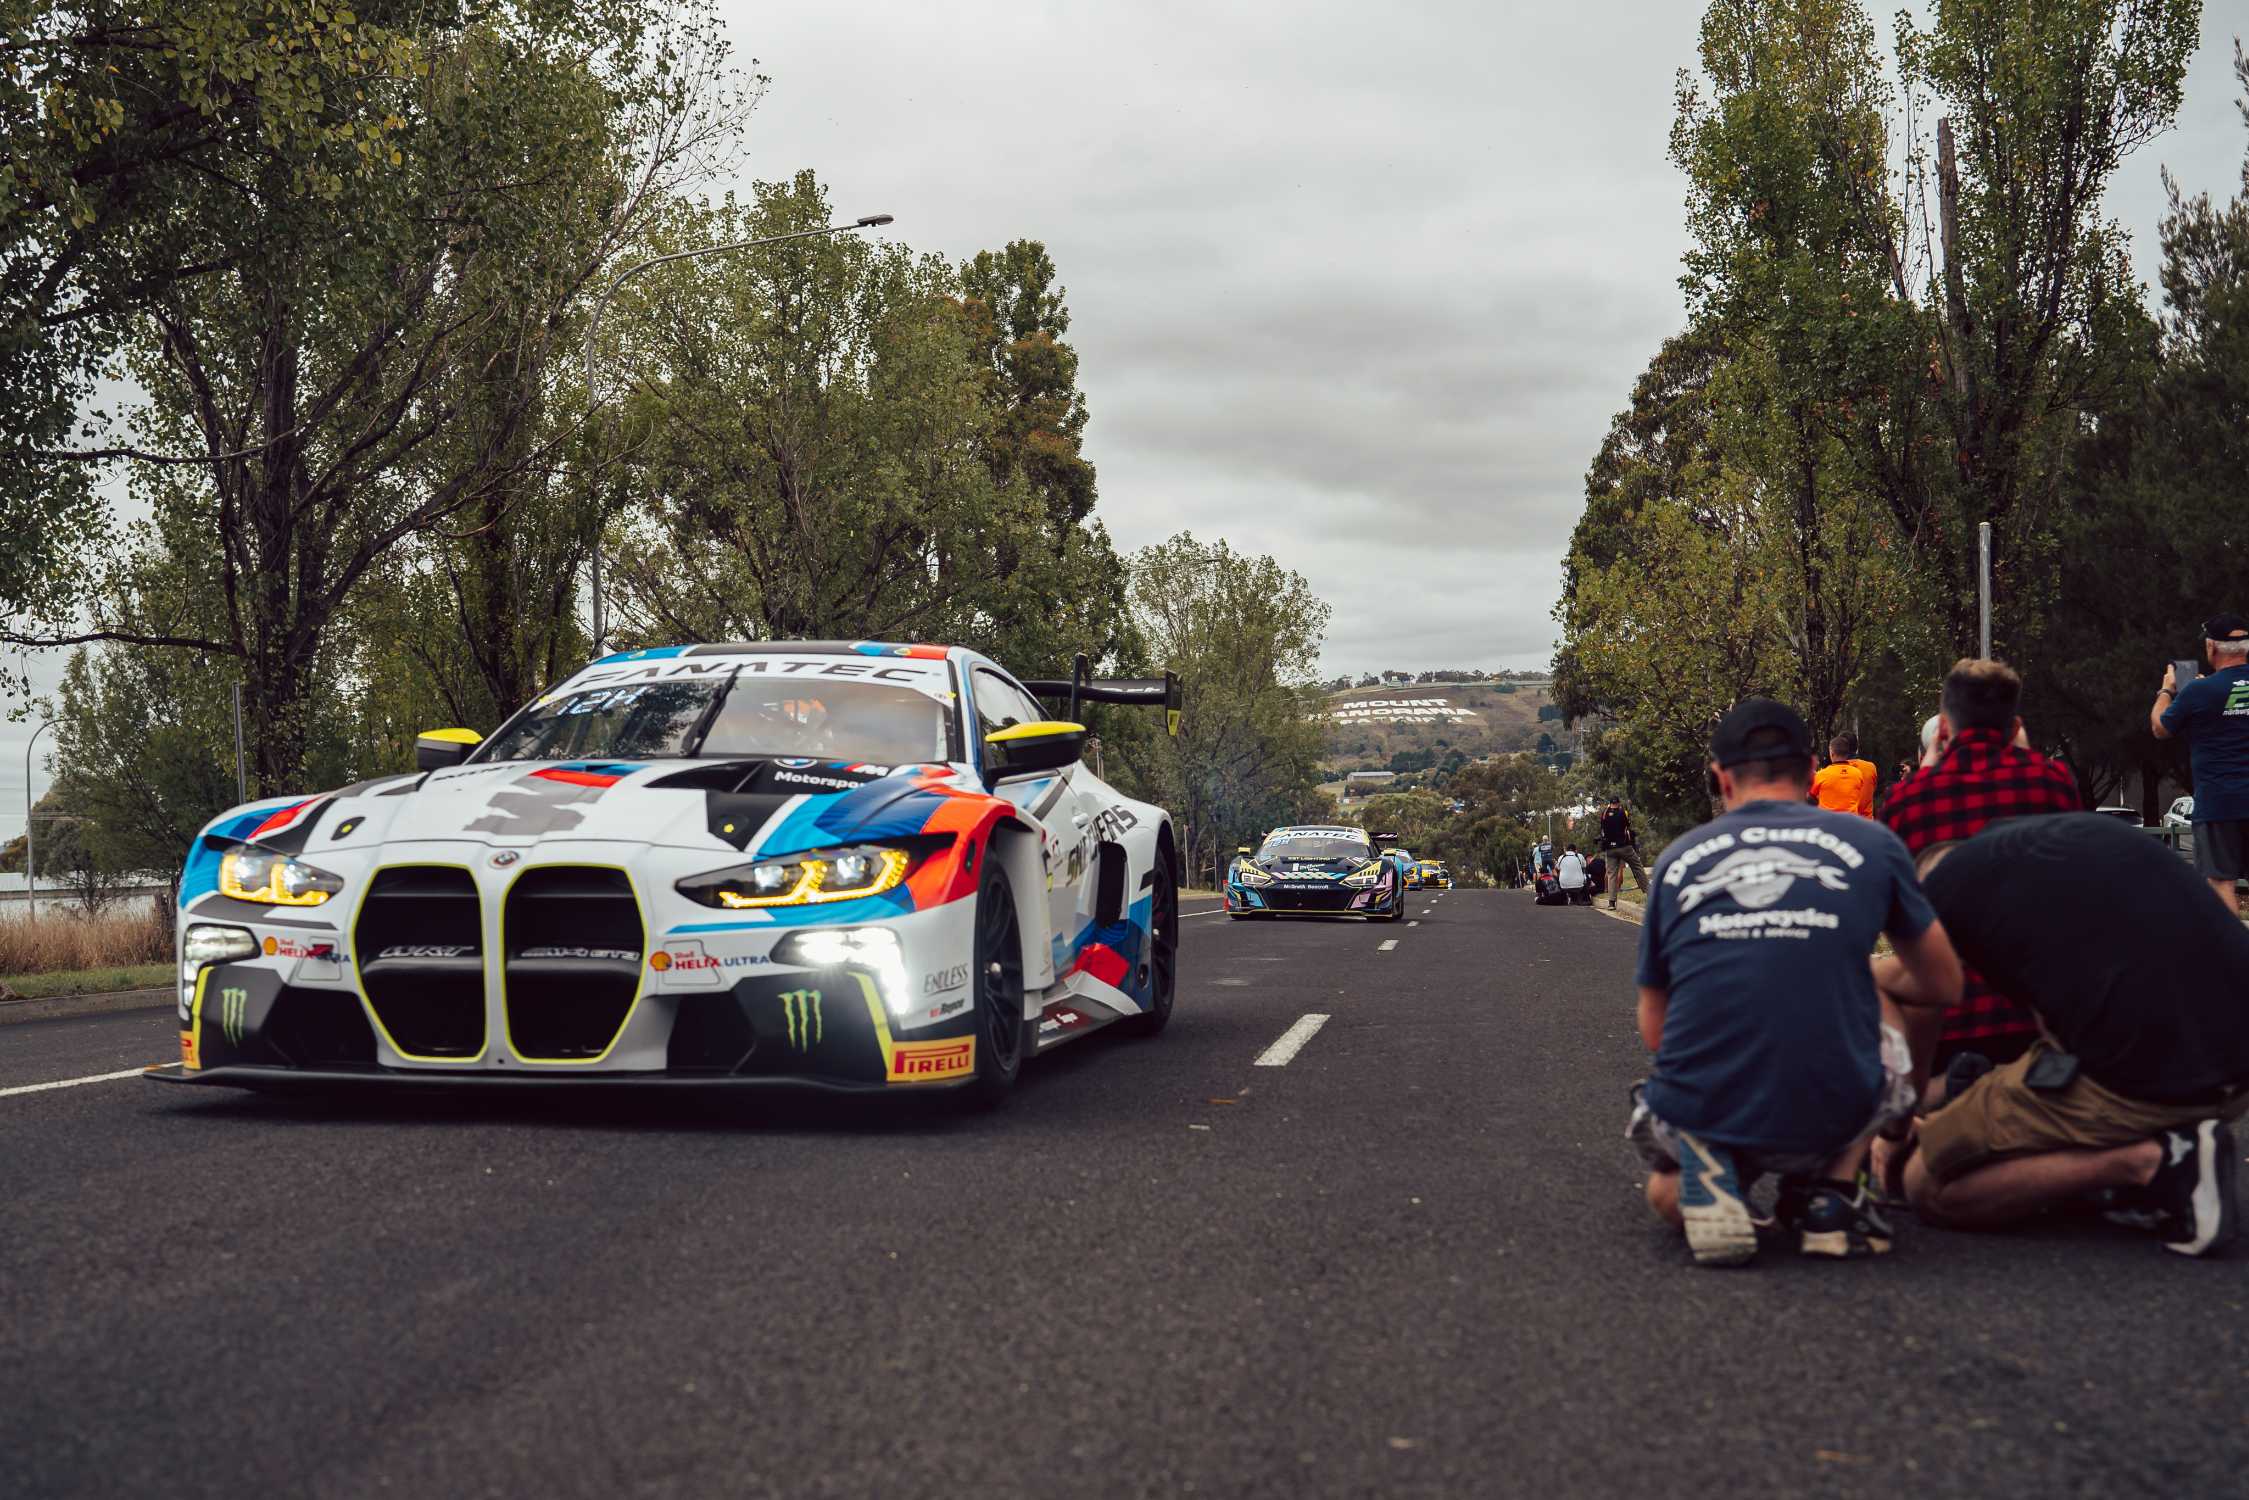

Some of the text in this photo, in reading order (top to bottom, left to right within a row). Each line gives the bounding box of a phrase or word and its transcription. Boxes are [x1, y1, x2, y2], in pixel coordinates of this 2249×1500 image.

[571, 662, 928, 688] FANATEC
[1343, 698, 1448, 709] MOUNT
[675, 955, 769, 970] HELIX ULTRA
[923, 962, 969, 993] ENDLESS
[894, 1043, 970, 1074] PIRELLI
